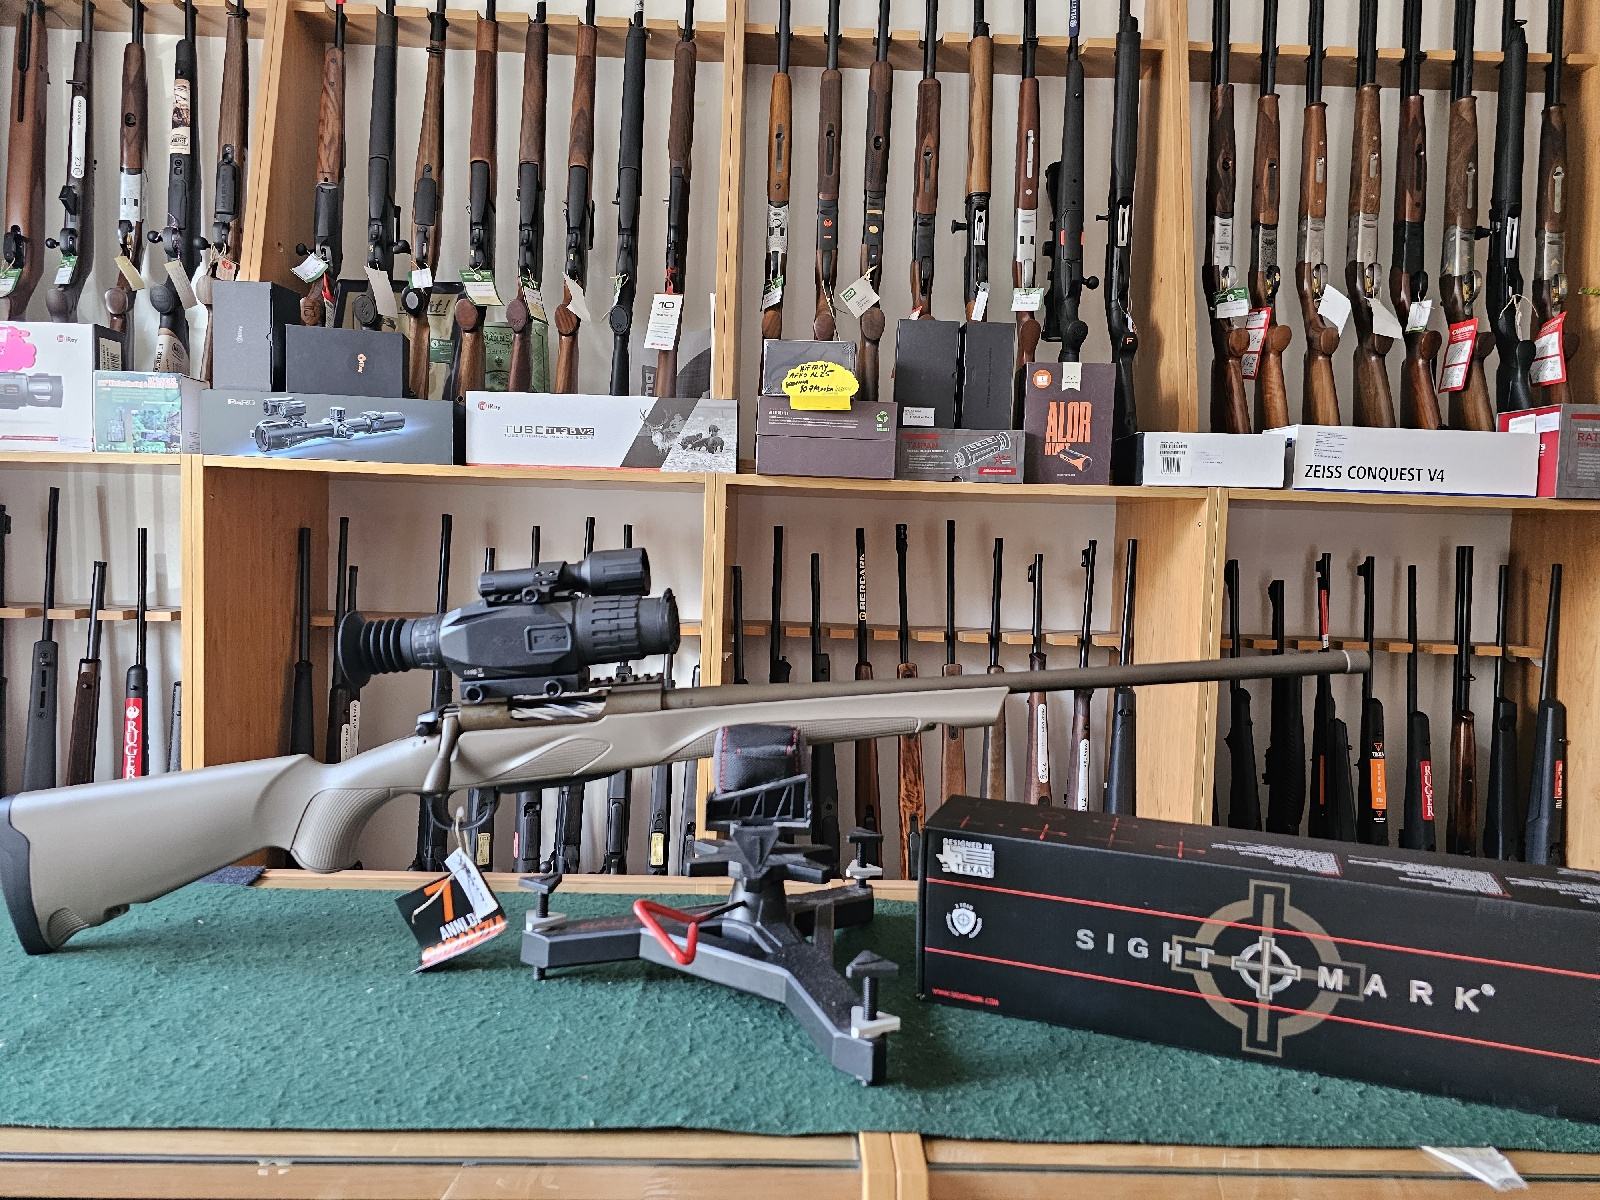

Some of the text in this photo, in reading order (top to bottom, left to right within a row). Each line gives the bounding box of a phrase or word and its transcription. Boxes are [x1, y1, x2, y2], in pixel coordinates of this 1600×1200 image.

[505, 425, 544, 435] TUBE
[579, 427, 595, 436] V2
[1045, 401, 1092, 443] ALOR
[1304, 464, 1445, 483] ZEISS CONQUEST V4
[126, 720, 139, 780] RUGER
[1424, 765, 1434, 817] RUGER
[943, 837, 993, 851] DESIGNED IN
[956, 862, 991, 875] TEXAS
[439, 916, 468, 941] ANNI
[1075, 928, 1215, 969] SIGHT
